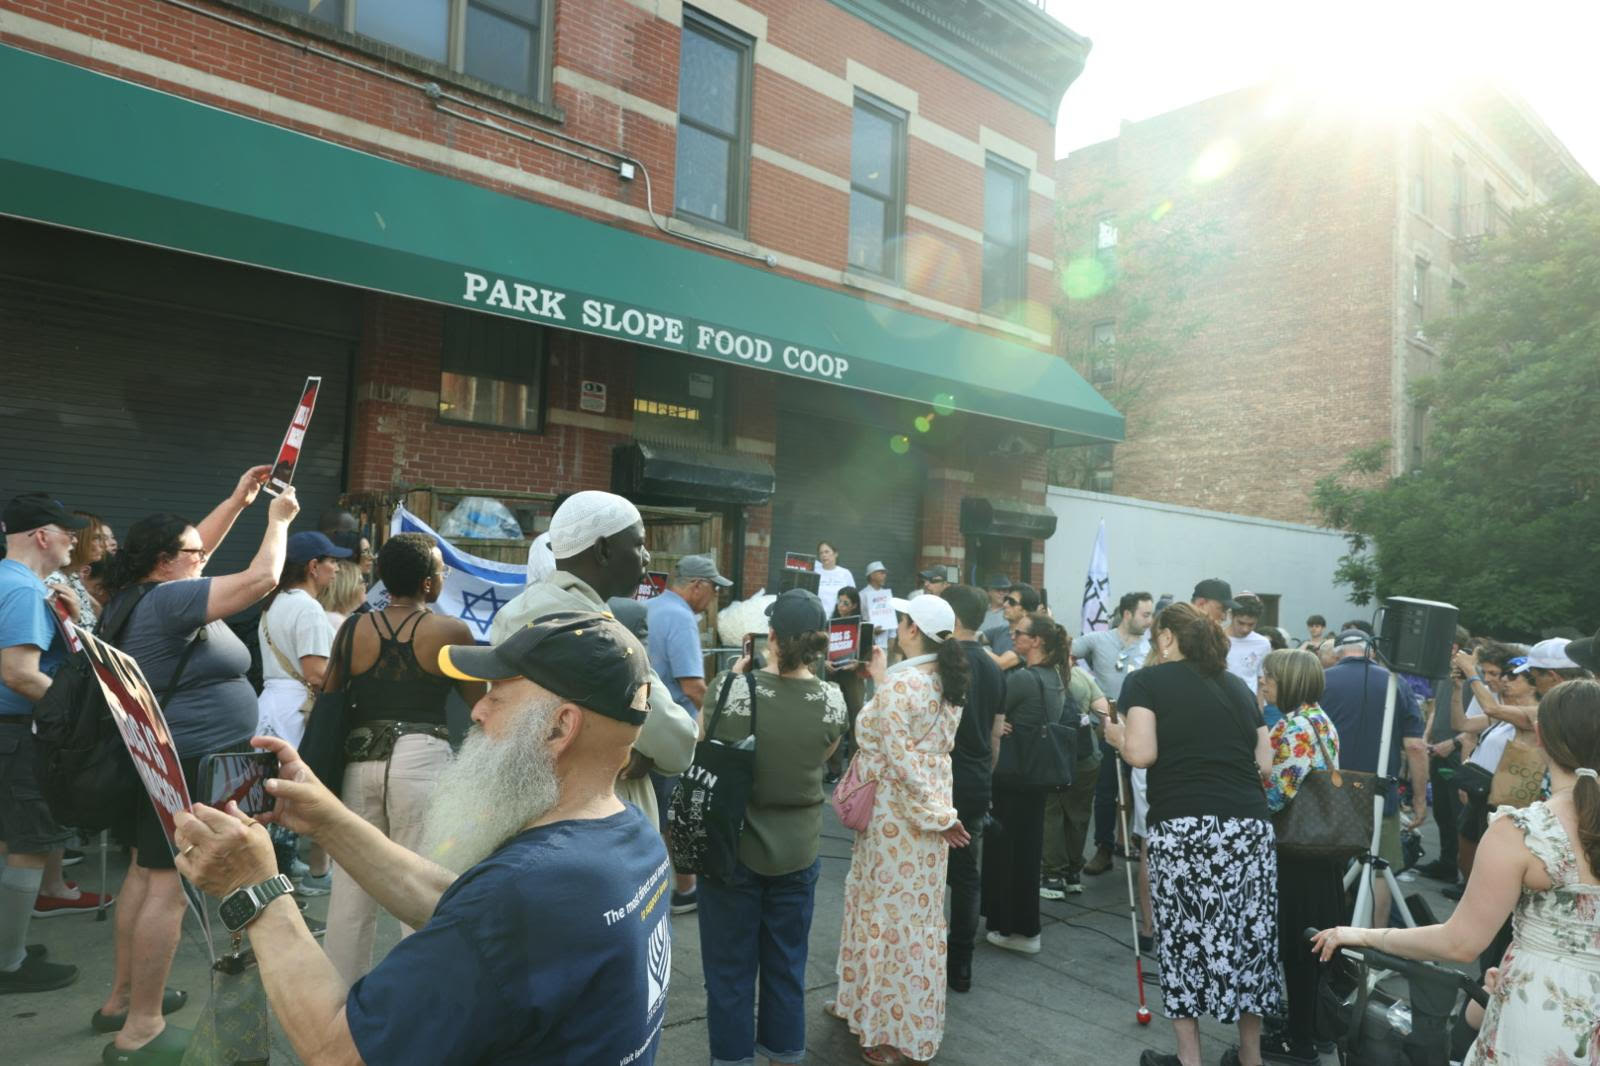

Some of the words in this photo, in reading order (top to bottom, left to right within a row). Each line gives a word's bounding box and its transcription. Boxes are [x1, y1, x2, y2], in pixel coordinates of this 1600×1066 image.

[463, 272, 566, 320] PARK
[582, 299, 684, 345] SLOPE
[697, 325, 773, 363] FOOD
[783, 346, 849, 379] COOP
[680, 765, 718, 789] LYN
[603, 907, 626, 926] The
[626, 892, 641, 914] most
